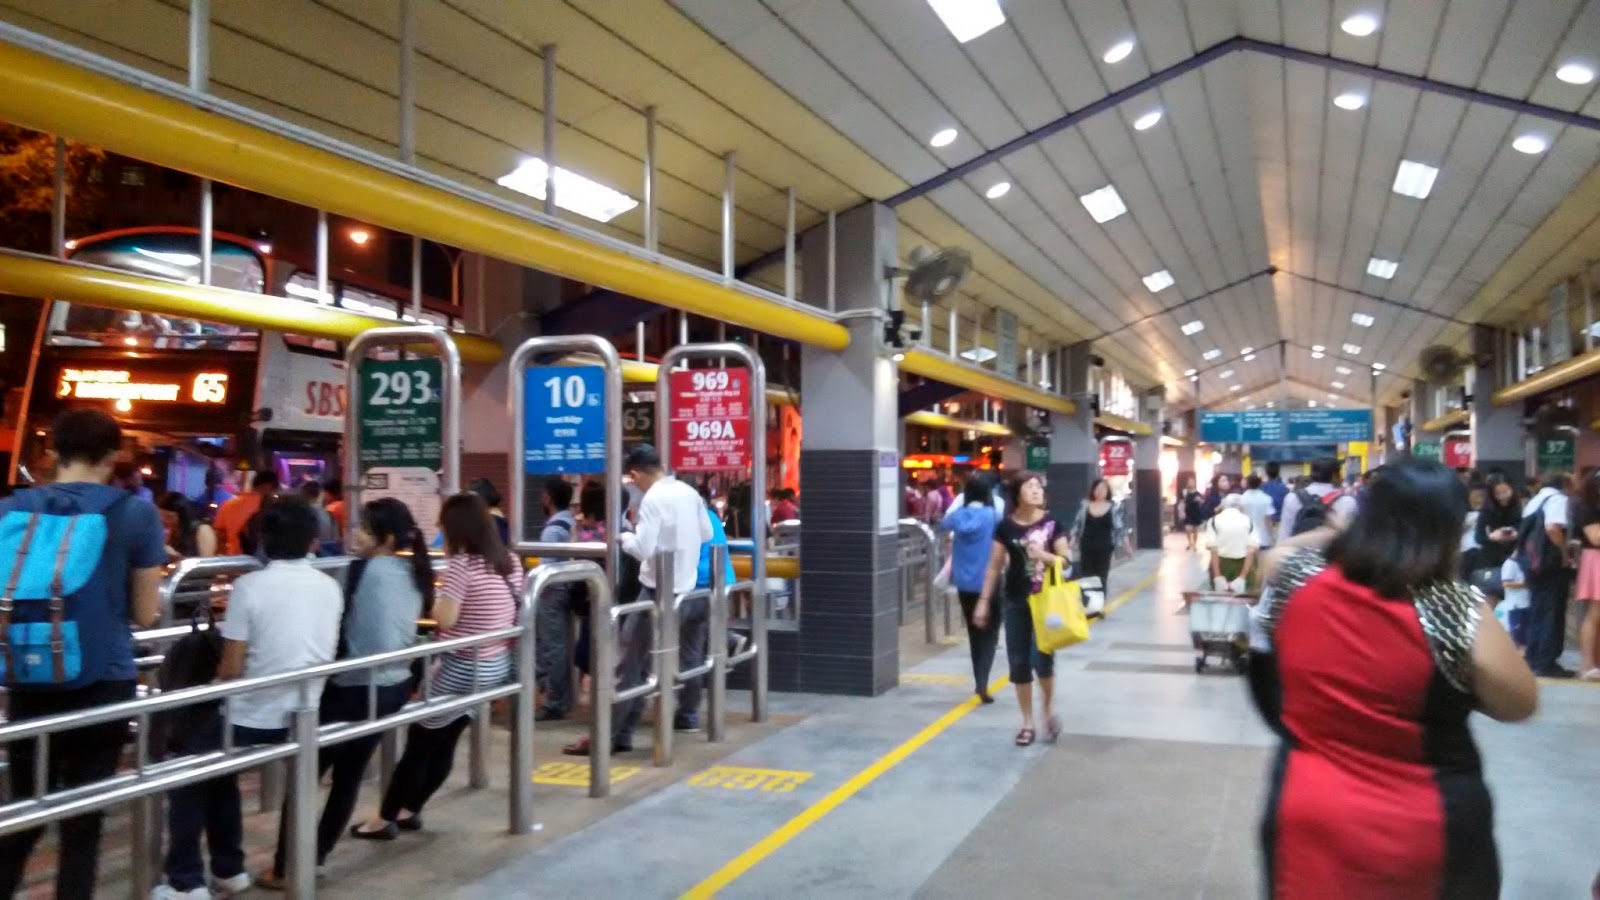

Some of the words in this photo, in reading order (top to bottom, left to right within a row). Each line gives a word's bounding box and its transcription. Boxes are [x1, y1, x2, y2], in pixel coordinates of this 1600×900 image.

[193, 373, 228, 402] 65
[370, 370, 431, 405] 293
[544, 375, 586, 408] 10
[692, 371, 728, 390] 969
[305, 380, 345, 416] SBS
[622, 408, 650, 430] 65
[687, 420, 735, 440] 969A
[1108, 447, 1125, 457] 22
